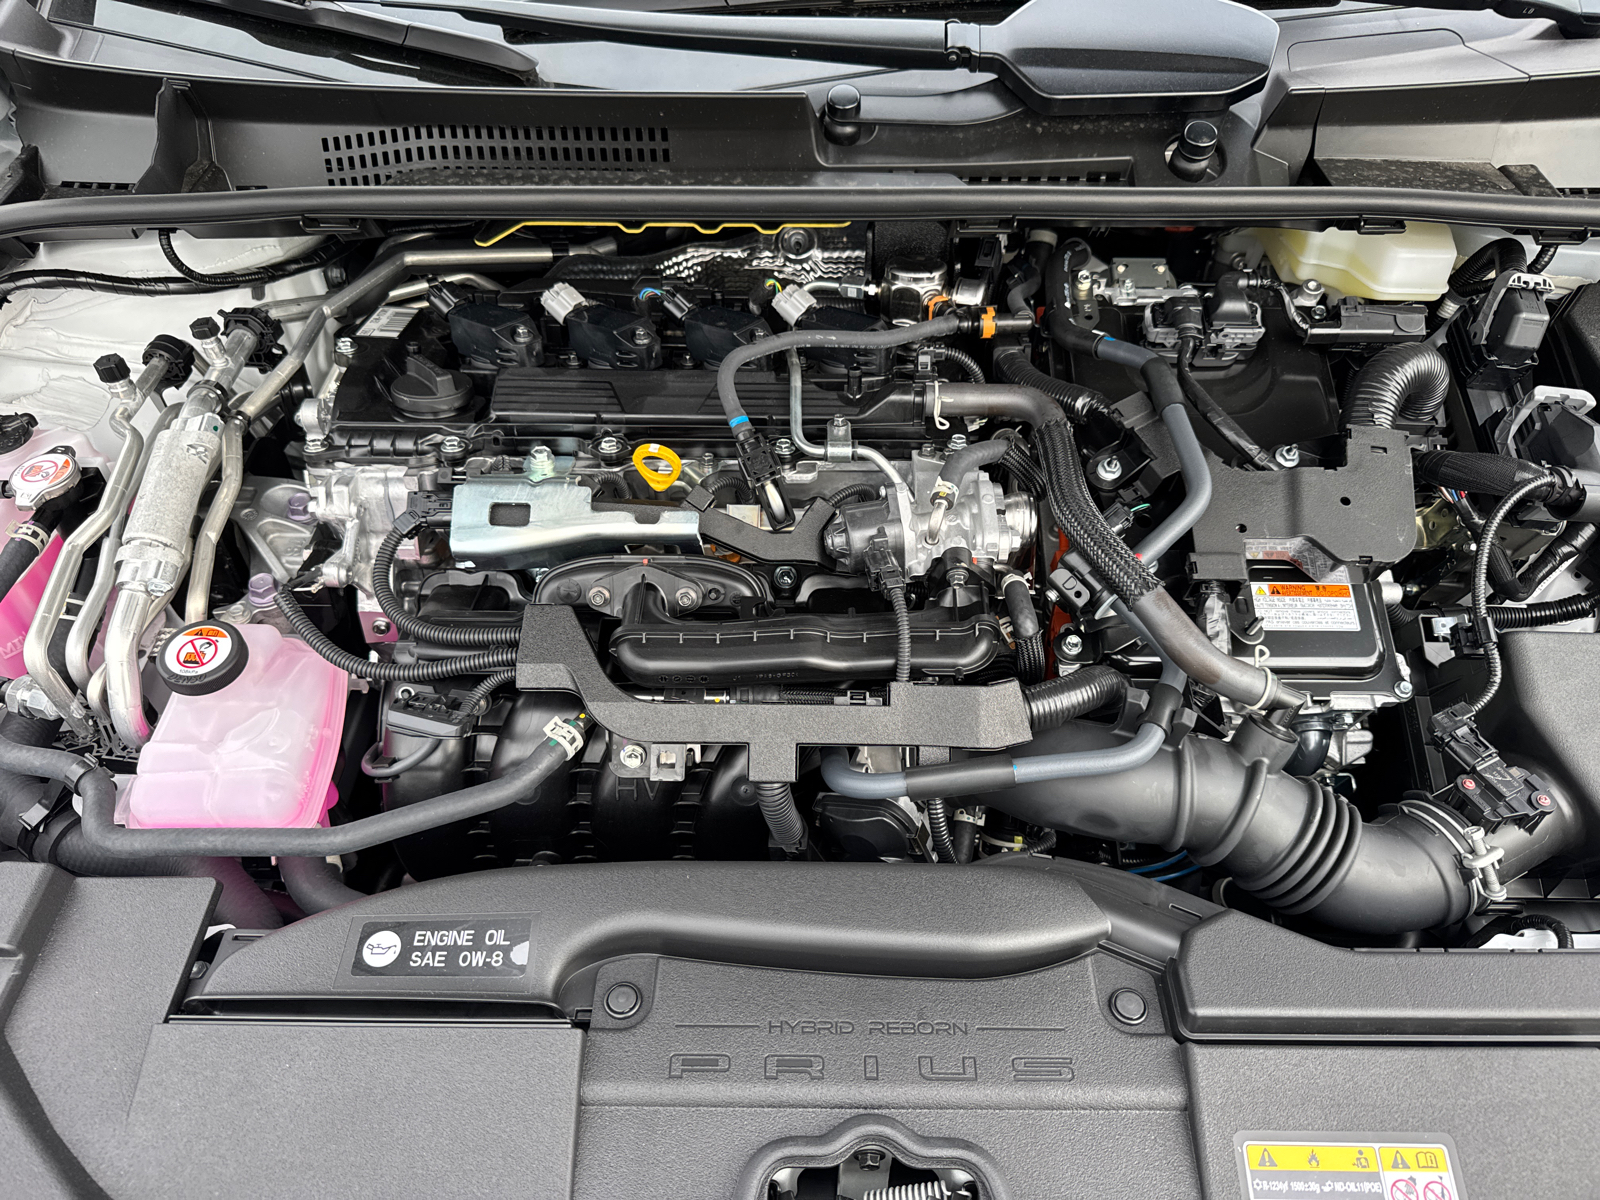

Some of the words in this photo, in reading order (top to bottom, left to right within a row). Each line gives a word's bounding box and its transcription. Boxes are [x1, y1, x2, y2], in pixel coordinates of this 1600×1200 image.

[413, 930, 475, 946] ENGINE
[484, 929, 511, 946] OIL
[409, 951, 448, 967] SAE
[458, 951, 504, 967] 0W-8
[767, 1019, 855, 1035] HYBRID
[868, 1020, 969, 1036] REBORN
[667, 1051, 1076, 1082] PRIUS
